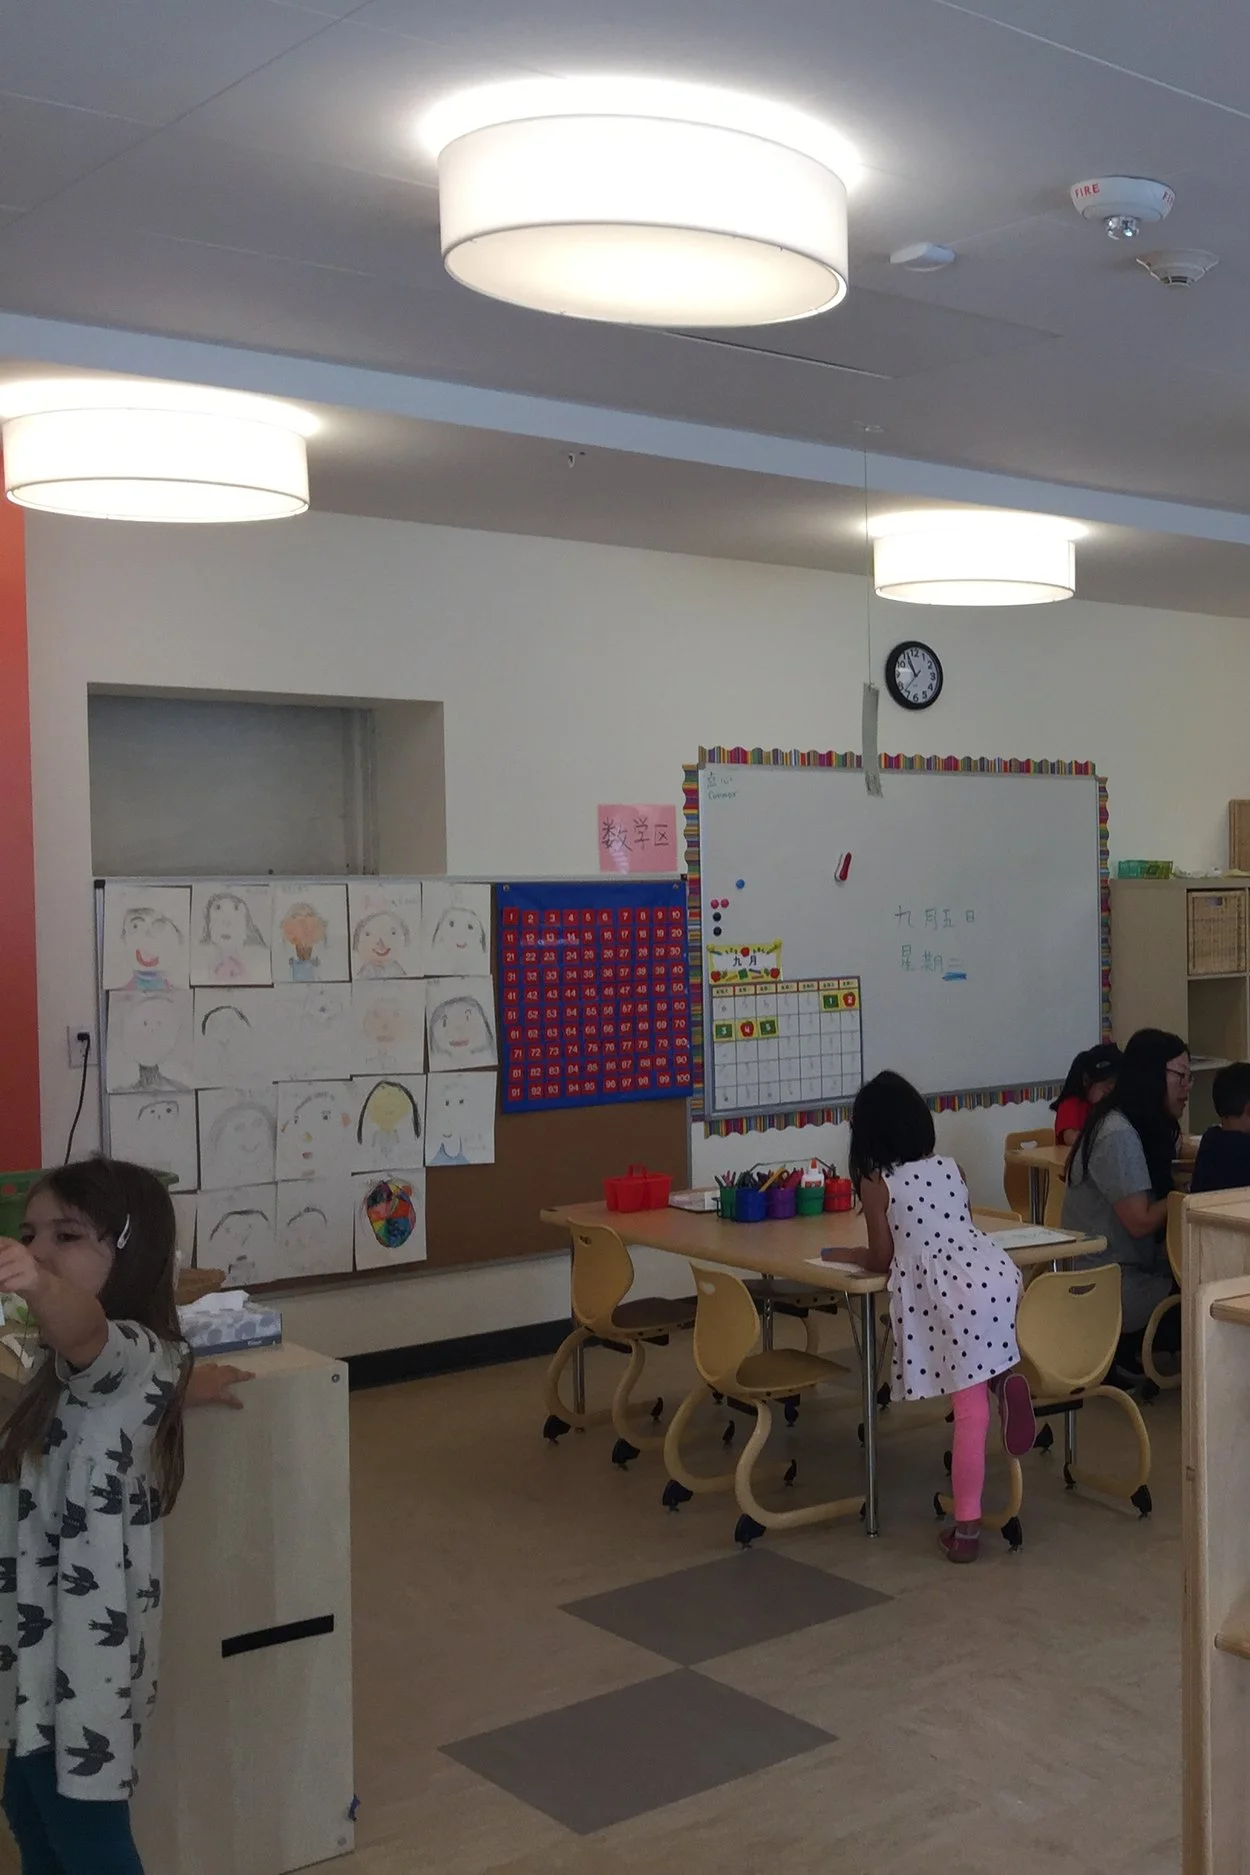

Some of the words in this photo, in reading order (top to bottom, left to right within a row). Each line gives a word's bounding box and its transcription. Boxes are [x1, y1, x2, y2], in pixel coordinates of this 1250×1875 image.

[1074, 183, 1101, 199] FIRE
[601, 817, 669, 852] 数学区
[672, 910, 681, 919] 10
[506, 934, 514, 942] 11
[526, 933, 535, 942] 12
[546, 933, 555, 942] 13
[567, 933, 576, 941] 14
[621, 930, 629, 938] 17
[656, 929, 664, 938] 19
[671, 928, 683, 938] 20
[506, 952, 515, 962] 21
[525, 952, 536, 962] 22
[543, 952, 556, 961] 23
[566, 951, 577, 960] 24
[619, 948, 629, 958] 27
[655, 947, 665, 956] 29
[670, 946, 681, 956] 30
[732, 955, 757, 967] 九月
[507, 972, 516, 982] 31
[546, 971, 557, 980] 33
[566, 971, 577, 980] 34
[619, 968, 629, 977] 37
[655, 966, 665, 975] 39
[672, 965, 684, 974] 40
[507, 992, 516, 1000] 41
[526, 990, 538, 1000] 42
[546, 989, 558, 999] 43
[565, 989, 576, 998] 44
[619, 986, 630, 994] 47
[655, 984, 666, 992] 49
[674, 1019, 686, 1028] 70
[514, 1049, 522, 1058] 71
[531, 1048, 541, 1057] 72
[549, 1047, 559, 1056] 73
[567, 1045, 578, 1054] 74
[622, 1041, 632, 1050] 77
[658, 1038, 669, 1048] 79
[676, 1055, 688, 1064] 90
[511, 1088, 520, 1097] 91
[531, 1086, 542, 1096] 92
[547, 1085, 559, 1094] 93
[568, 1084, 579, 1092] 94
[621, 1078, 632, 1087] 97
[659, 1075, 670, 1084] 99
[676, 1073, 691, 1082] 100
